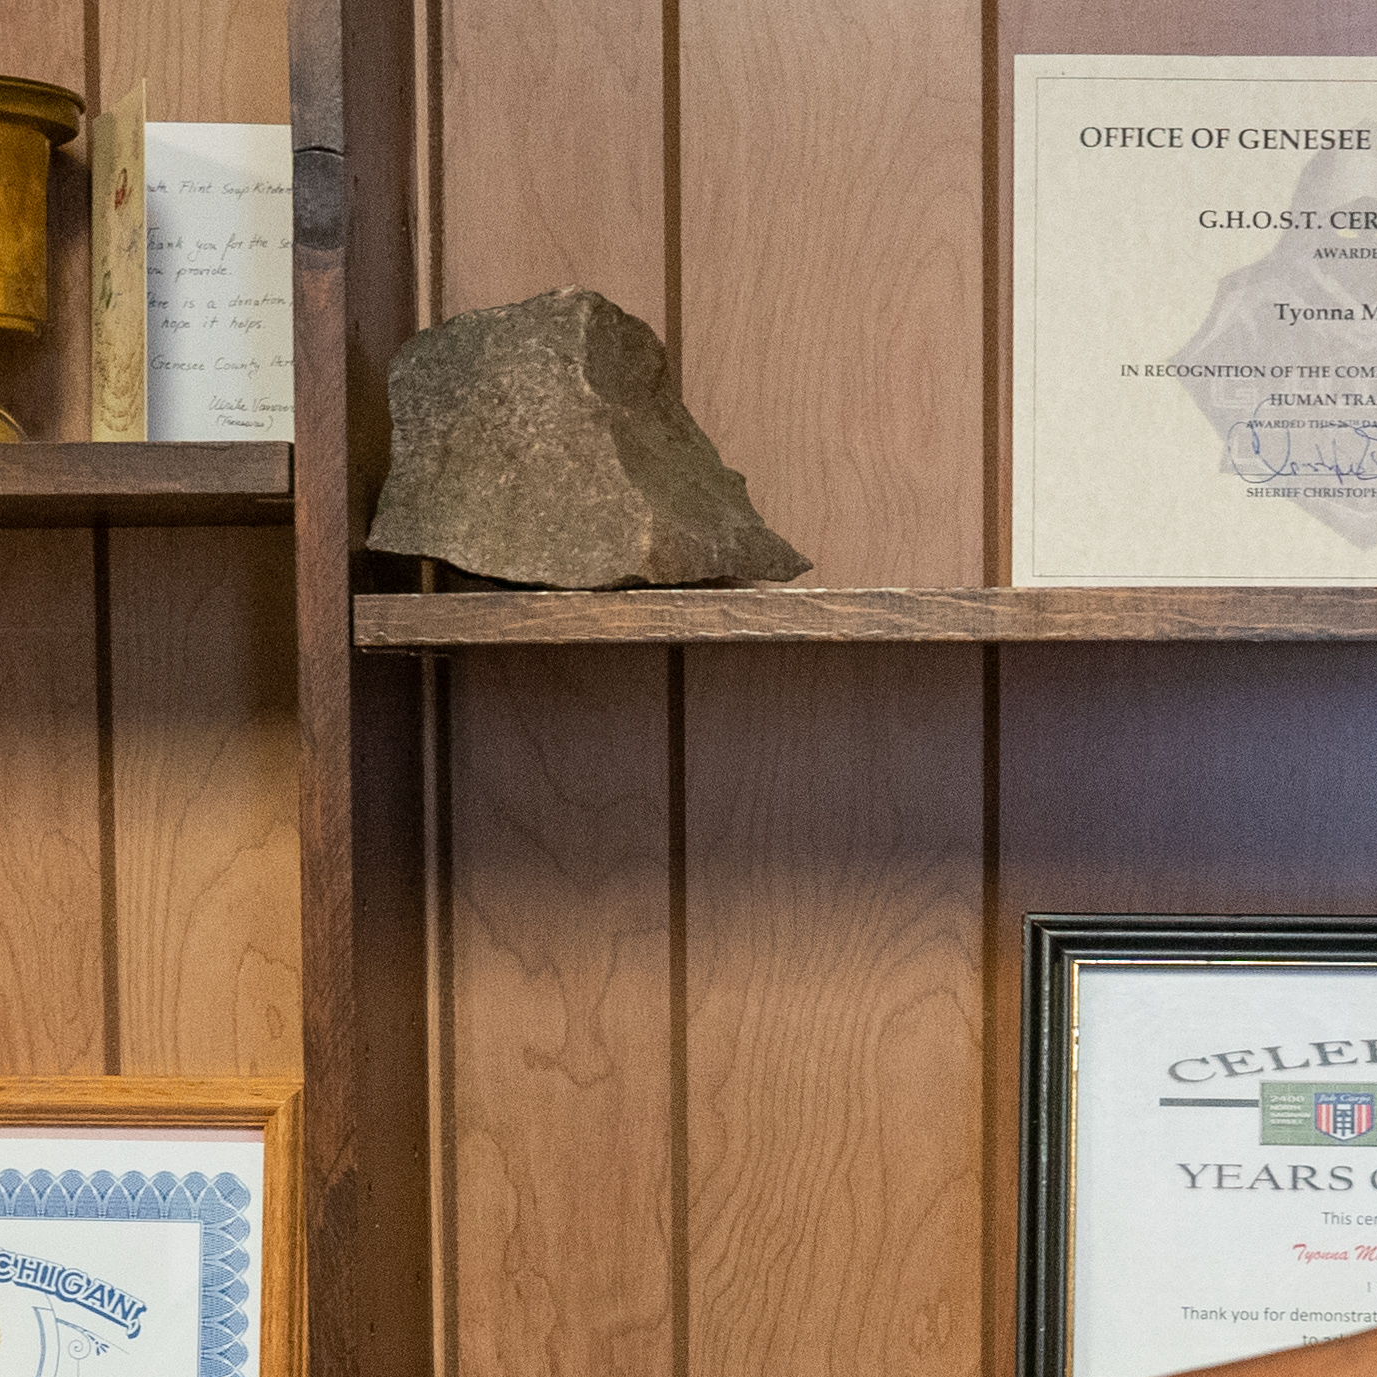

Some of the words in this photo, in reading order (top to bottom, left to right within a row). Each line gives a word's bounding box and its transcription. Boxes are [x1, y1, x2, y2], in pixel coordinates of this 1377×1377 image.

[1080, 127, 1183, 148] OFFICE
[1191, 128, 1230, 148] OF
[1238, 128, 1371, 150] GENESEE
[1199, 210, 1322, 231] G.H.O.S.T.
[1274, 304, 1354, 326] Tyonna
[1121, 365, 1140, 378] IN
[1144, 365, 1267, 379] RECOGNITION
[1270, 365, 1293, 379] OF
[1297, 365, 1330, 379] THE
[1270, 393, 1338, 407] HUMAN
[1247, 420, 1305, 430] AWARDED
[1247, 488, 1303, 498] SHERIFF
[1177, 1163, 1355, 1192] YEARS
[1322, 1211, 1352, 1227] This
[1292, 1243, 1348, 1264] Tyonna
[1181, 1306, 1227, 1321] Thank
[1231, 1310, 1259, 1324] you
[1264, 1306, 1285, 1321] for
